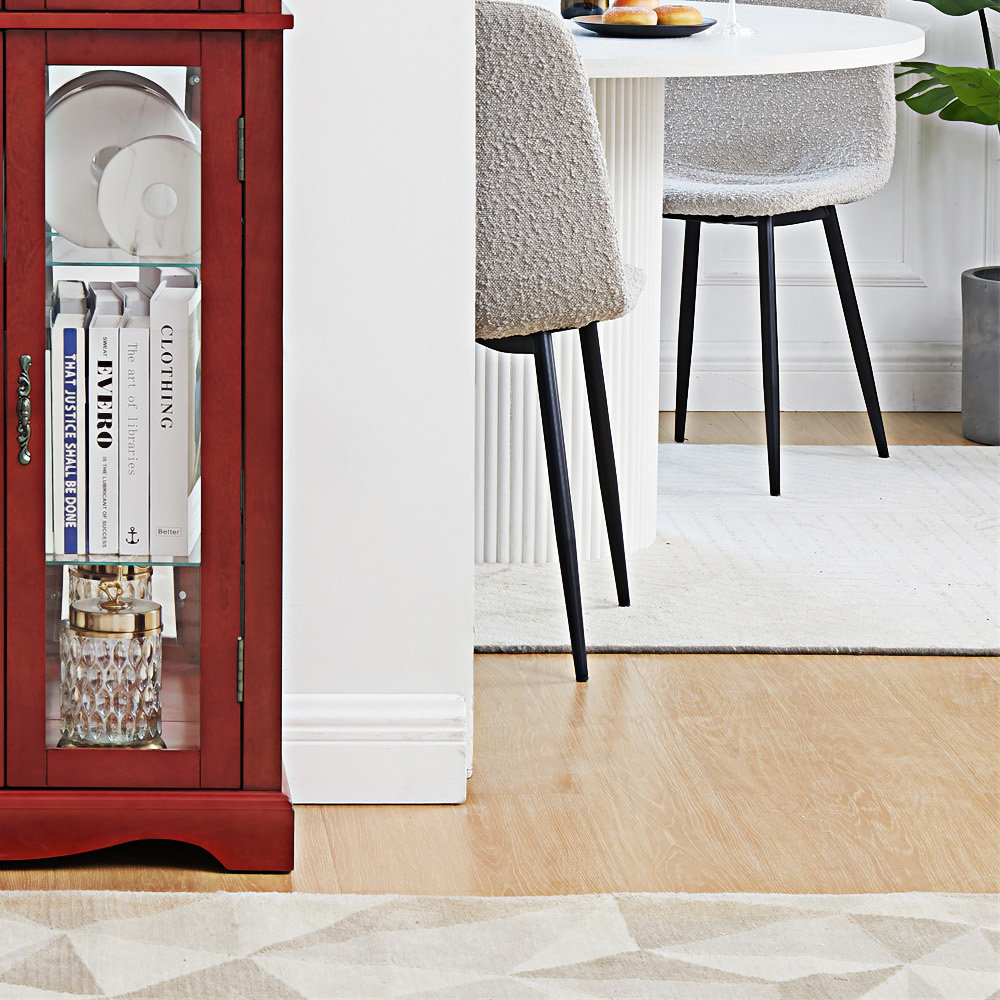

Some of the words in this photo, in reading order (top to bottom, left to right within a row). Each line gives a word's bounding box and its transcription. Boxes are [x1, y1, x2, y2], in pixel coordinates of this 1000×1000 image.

[127, 342, 138, 363] The
[64, 353, 76, 386] THAT
[127, 369, 136, 388] art
[160, 324, 173, 429] CLOTHING
[64, 389, 76, 438] JUSTICE
[96, 360, 113, 449] EVERO
[127, 395, 138, 410] of
[64, 442, 76, 478] SHALL
[127, 417, 138, 476] libraries
[65, 480, 76, 494] BE
[65, 496, 77, 528] DONE
[102, 511, 108, 519] OF
